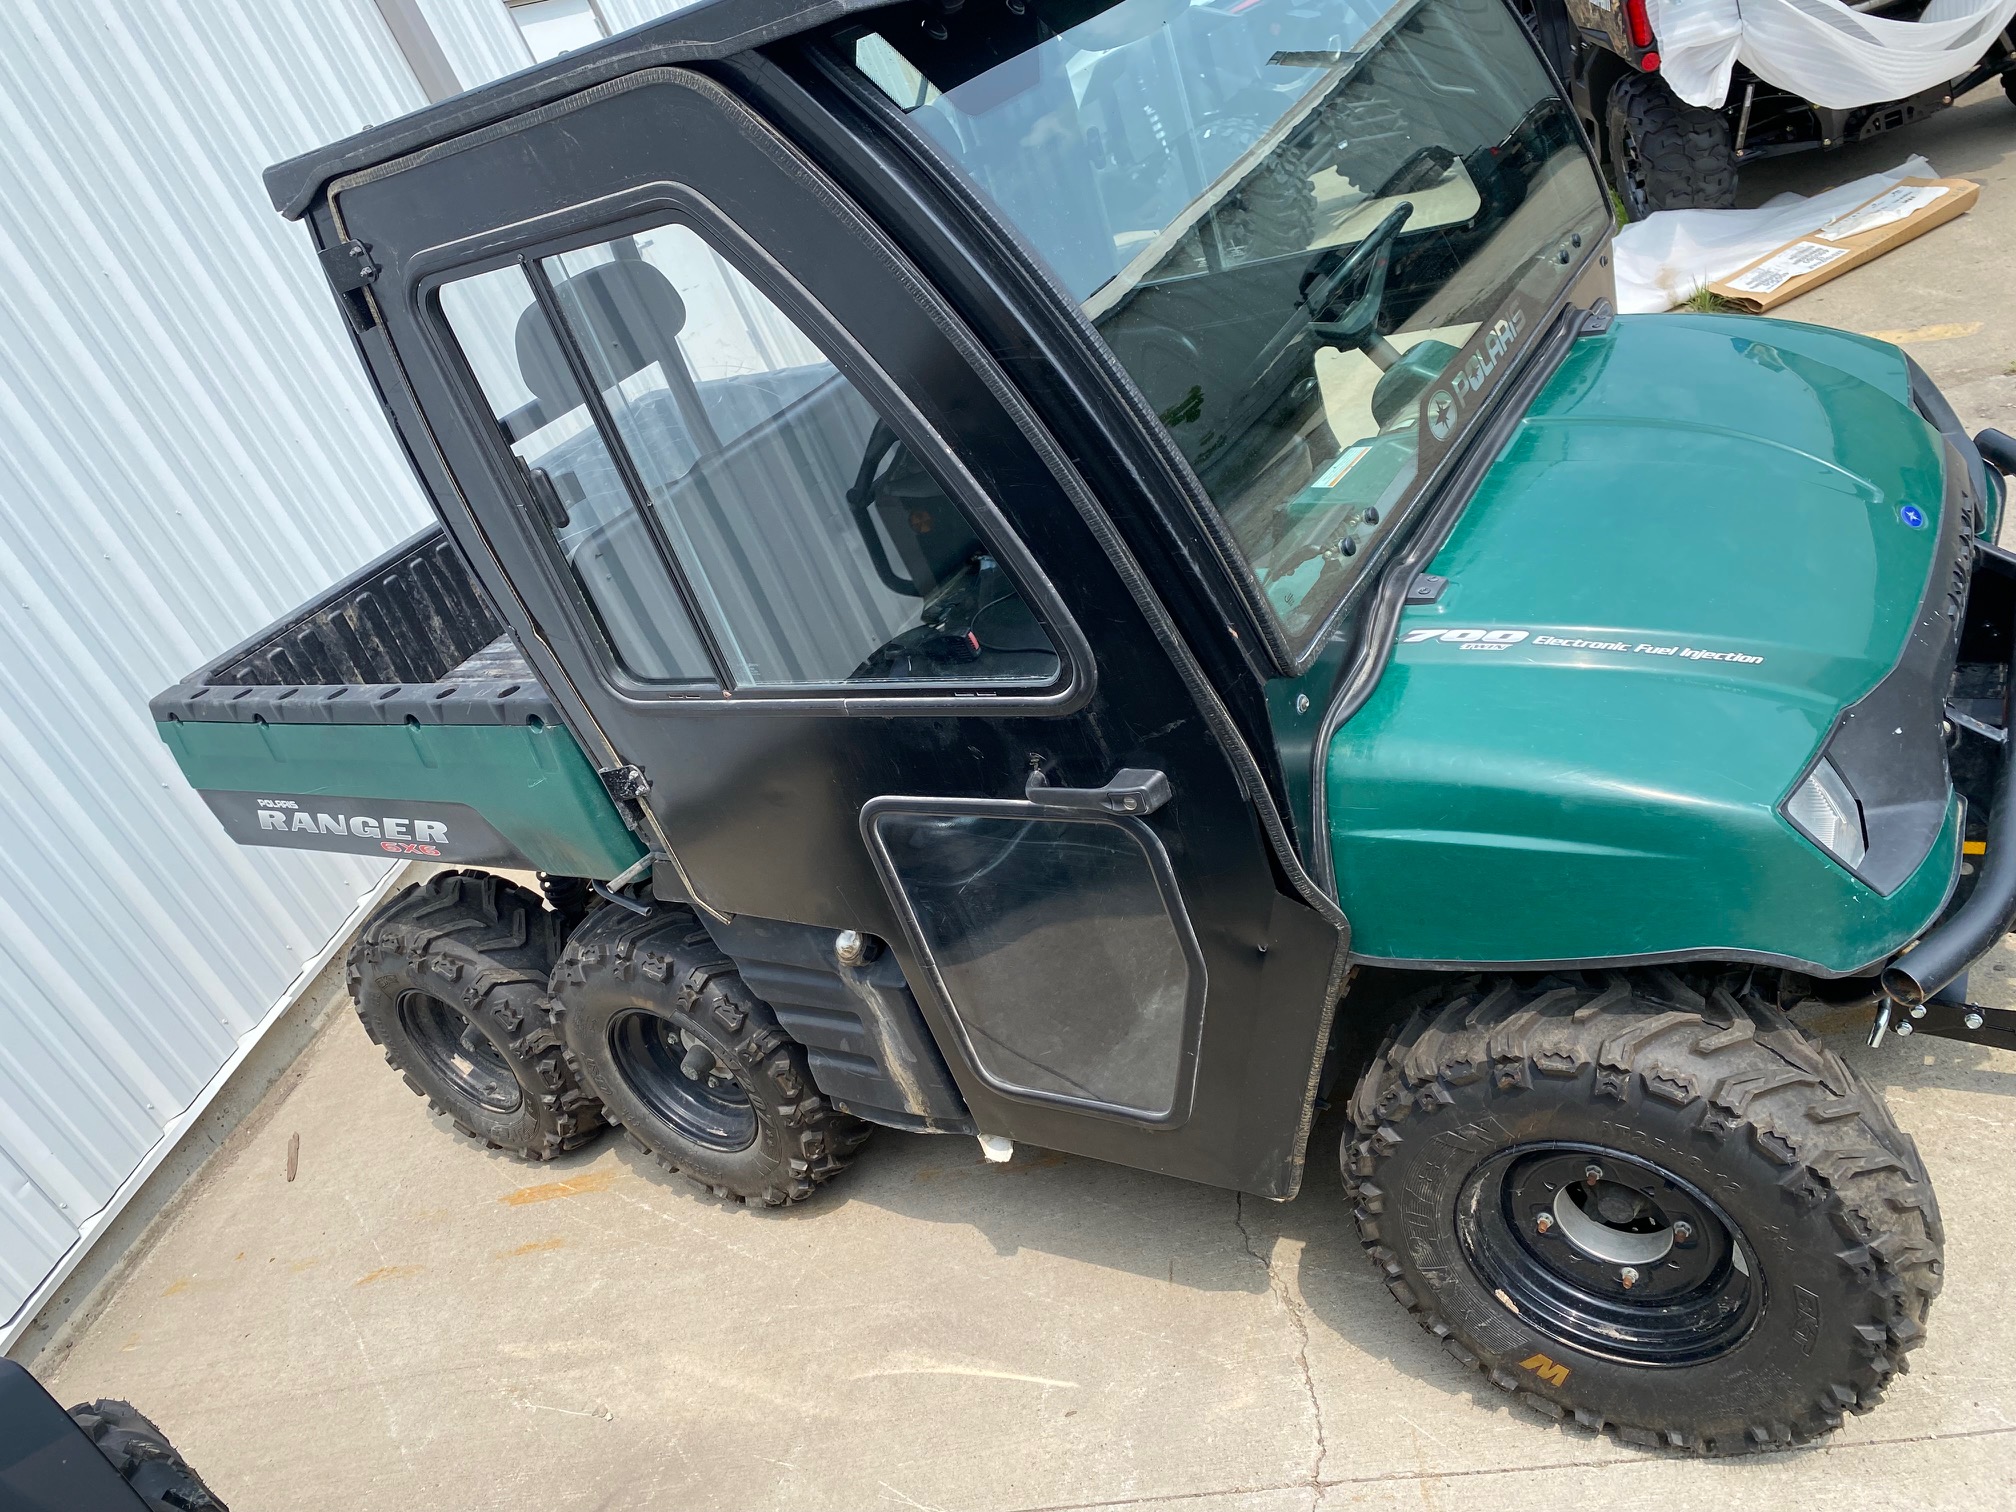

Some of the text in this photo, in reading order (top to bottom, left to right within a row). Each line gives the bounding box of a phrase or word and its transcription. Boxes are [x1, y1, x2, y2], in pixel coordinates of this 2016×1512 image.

[1451, 299, 1526, 409] POLARIS
[1402, 629, 1530, 643] 700
[1532, 635, 1764, 665] Electronic Fuel Injection
[256, 798, 299, 809] POLARIS
[257, 809, 450, 844] RANGER
[380, 841, 442, 857] 6X6
